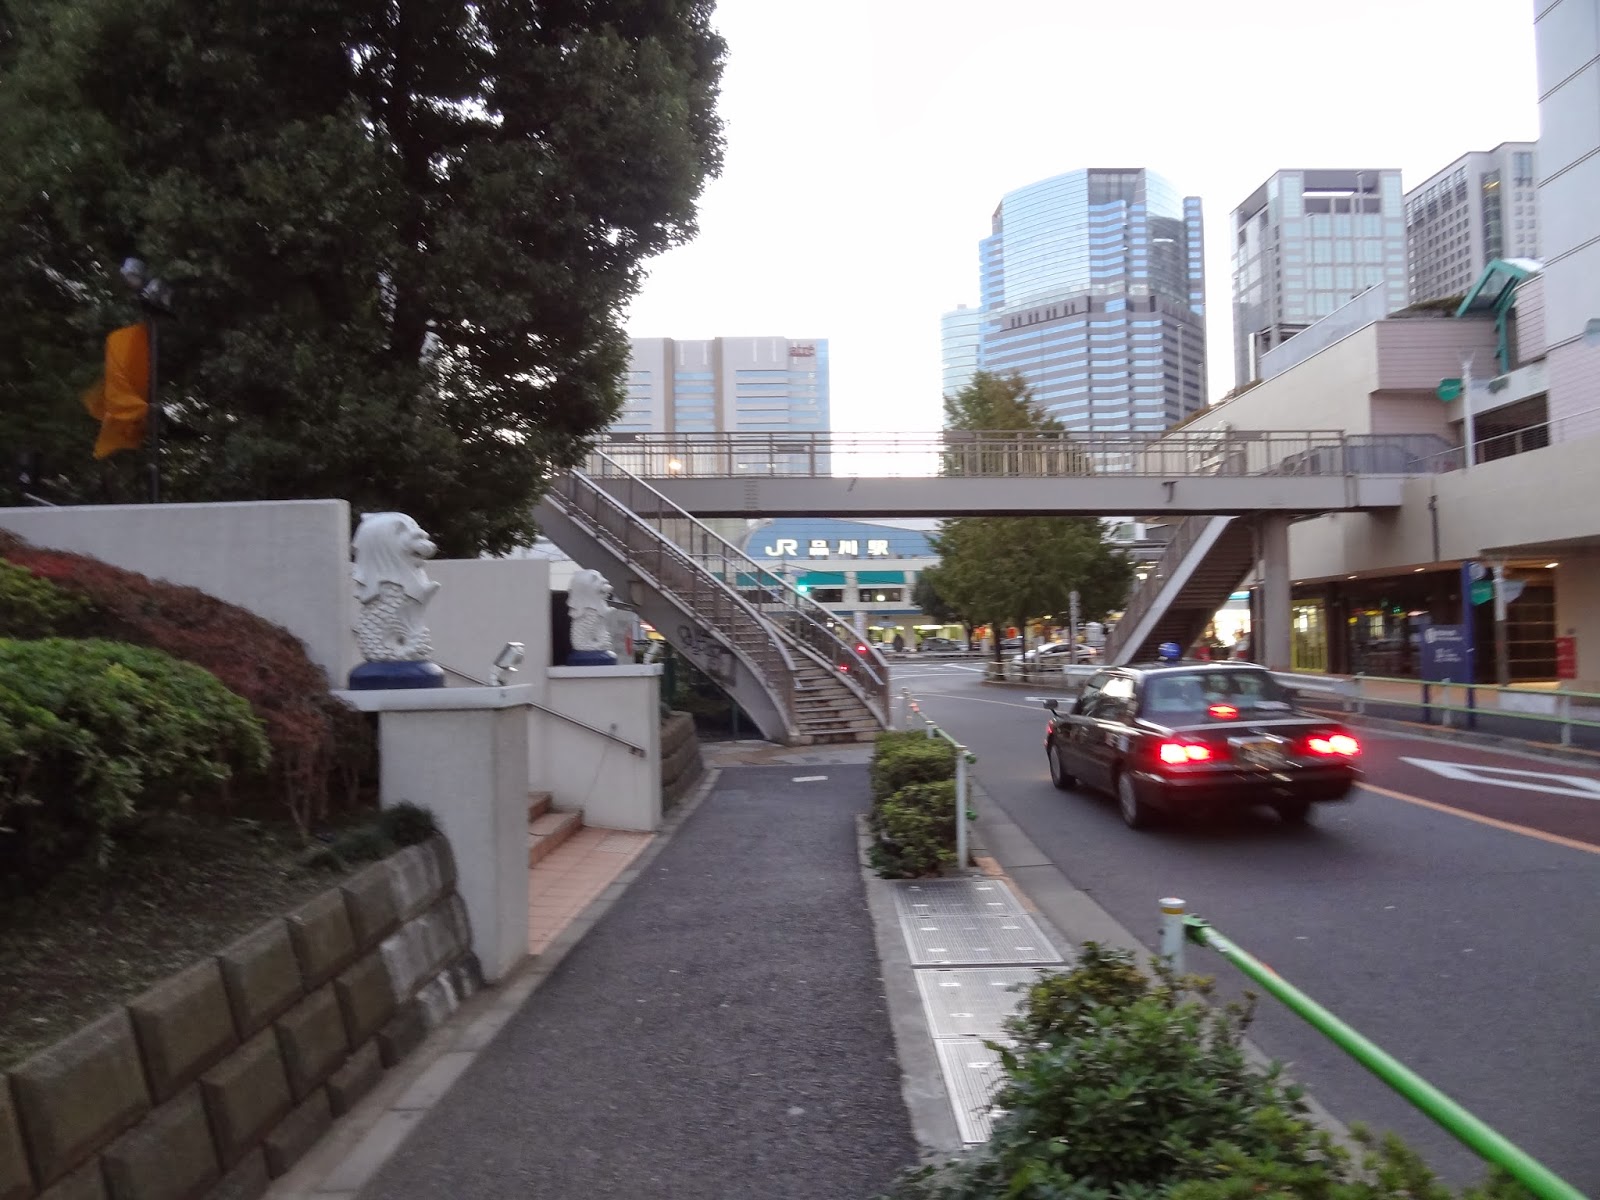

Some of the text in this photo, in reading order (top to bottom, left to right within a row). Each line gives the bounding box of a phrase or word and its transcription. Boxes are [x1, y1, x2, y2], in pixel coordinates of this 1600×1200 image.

[765, 539, 889, 556] JR 品川駅
